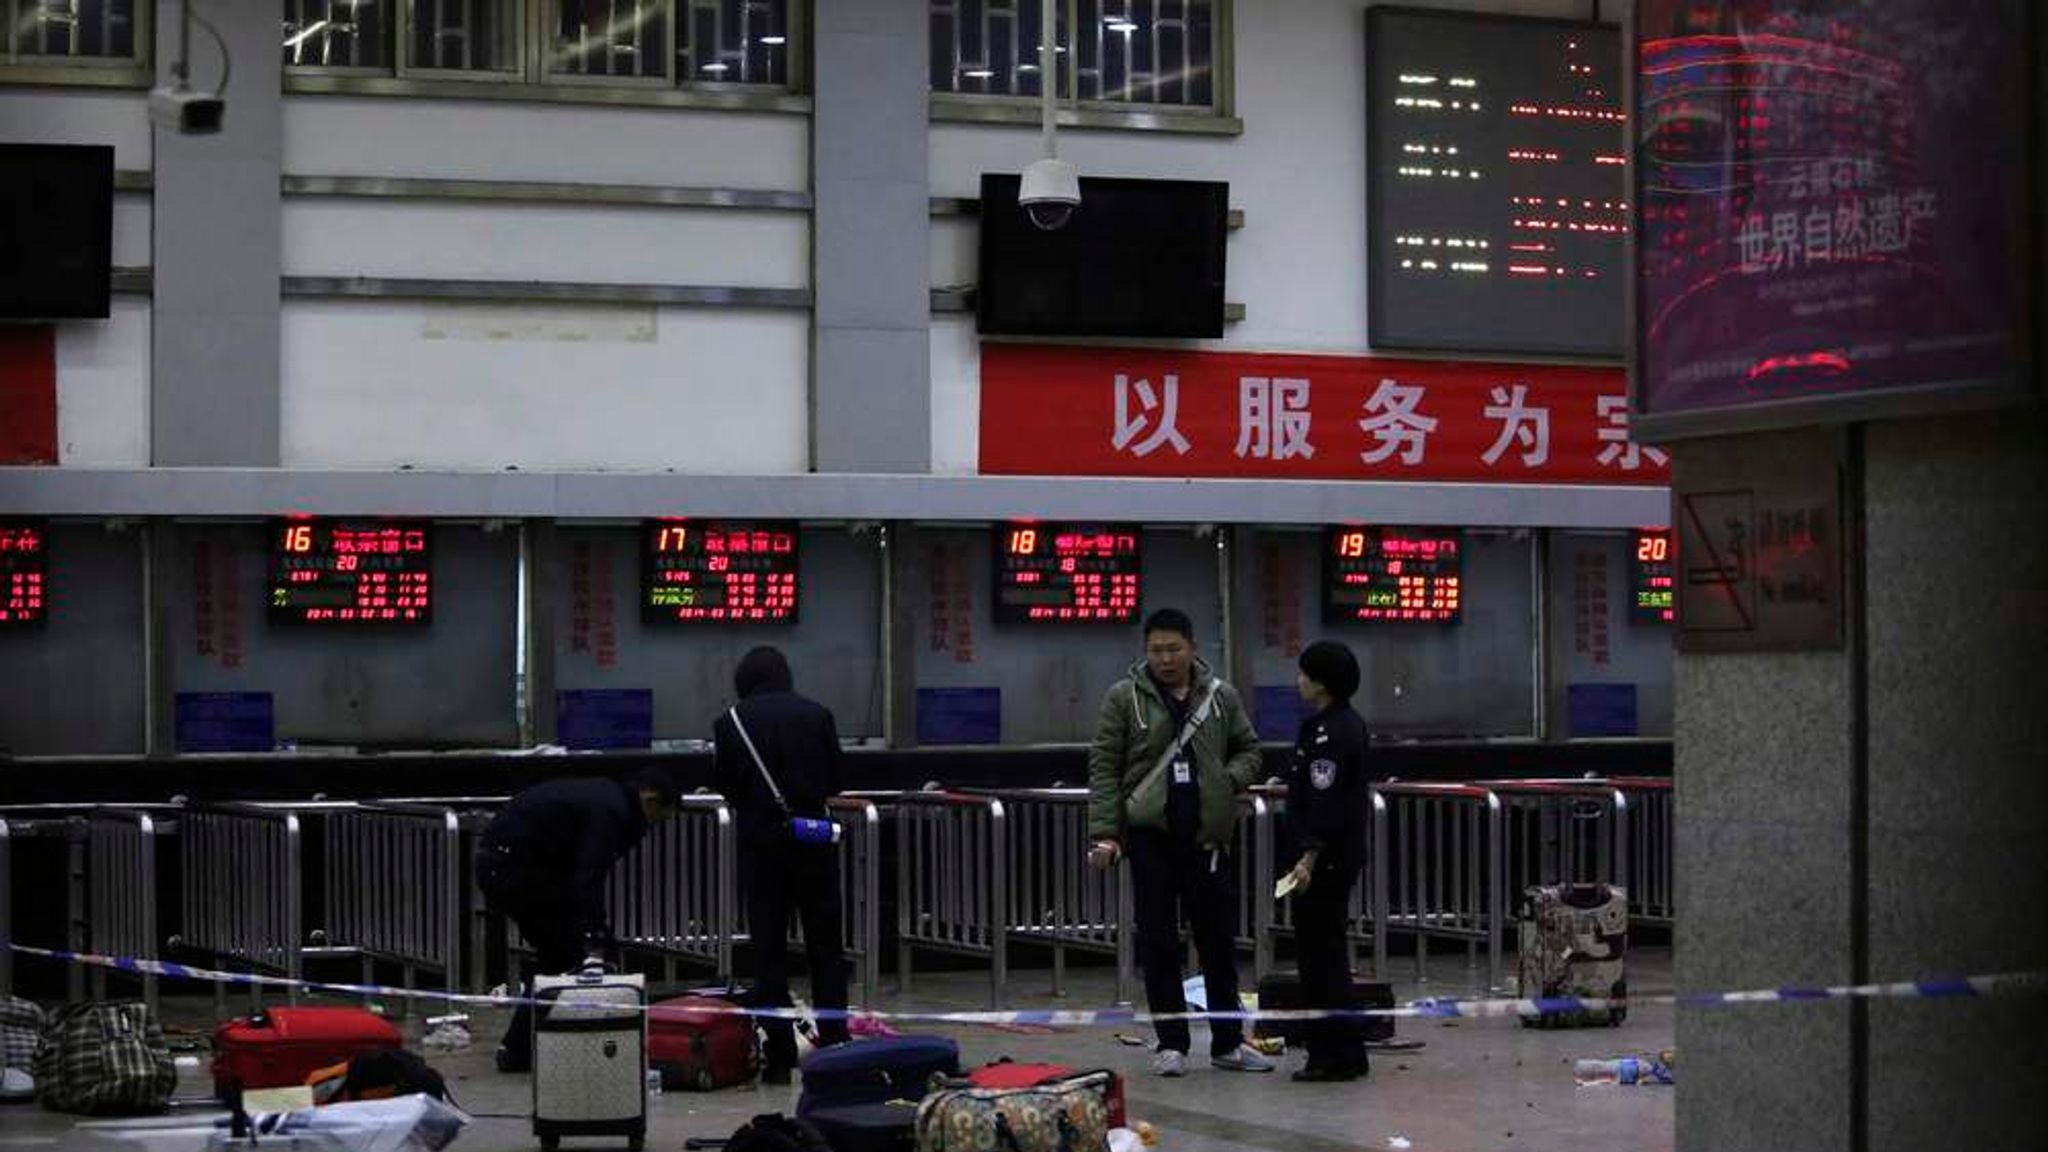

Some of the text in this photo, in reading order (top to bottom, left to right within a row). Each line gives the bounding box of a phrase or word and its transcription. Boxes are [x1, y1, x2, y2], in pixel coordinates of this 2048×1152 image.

[1733, 188, 1936, 275] 世界自然遗产
[286, 526, 311, 551] 16
[659, 528, 685, 551] 17
[1011, 530, 1036, 554] 18
[1341, 533, 1364, 557] 19
[1638, 538, 1667, 561] 20
[336, 555, 358, 570] 20
[708, 556, 728, 571] 20
